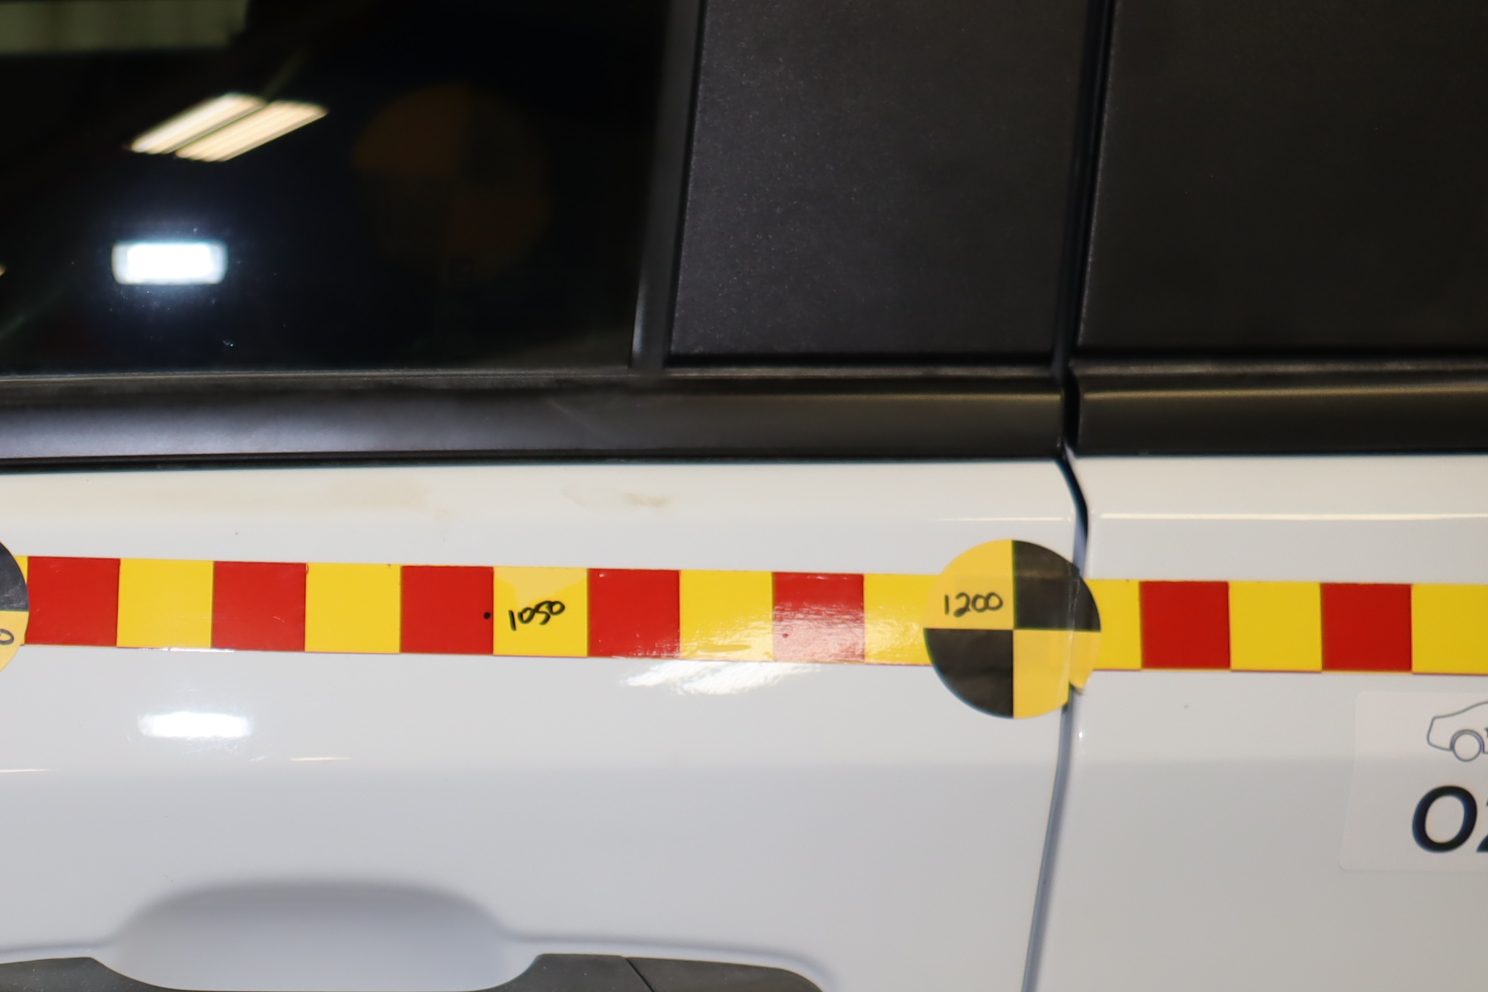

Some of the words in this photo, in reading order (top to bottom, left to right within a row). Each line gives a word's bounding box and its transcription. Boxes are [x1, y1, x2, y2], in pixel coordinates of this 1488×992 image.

[507, 599, 566, 631] 1050
[943, 591, 1004, 619] 1200
[1411, 784, 1488, 853] O
